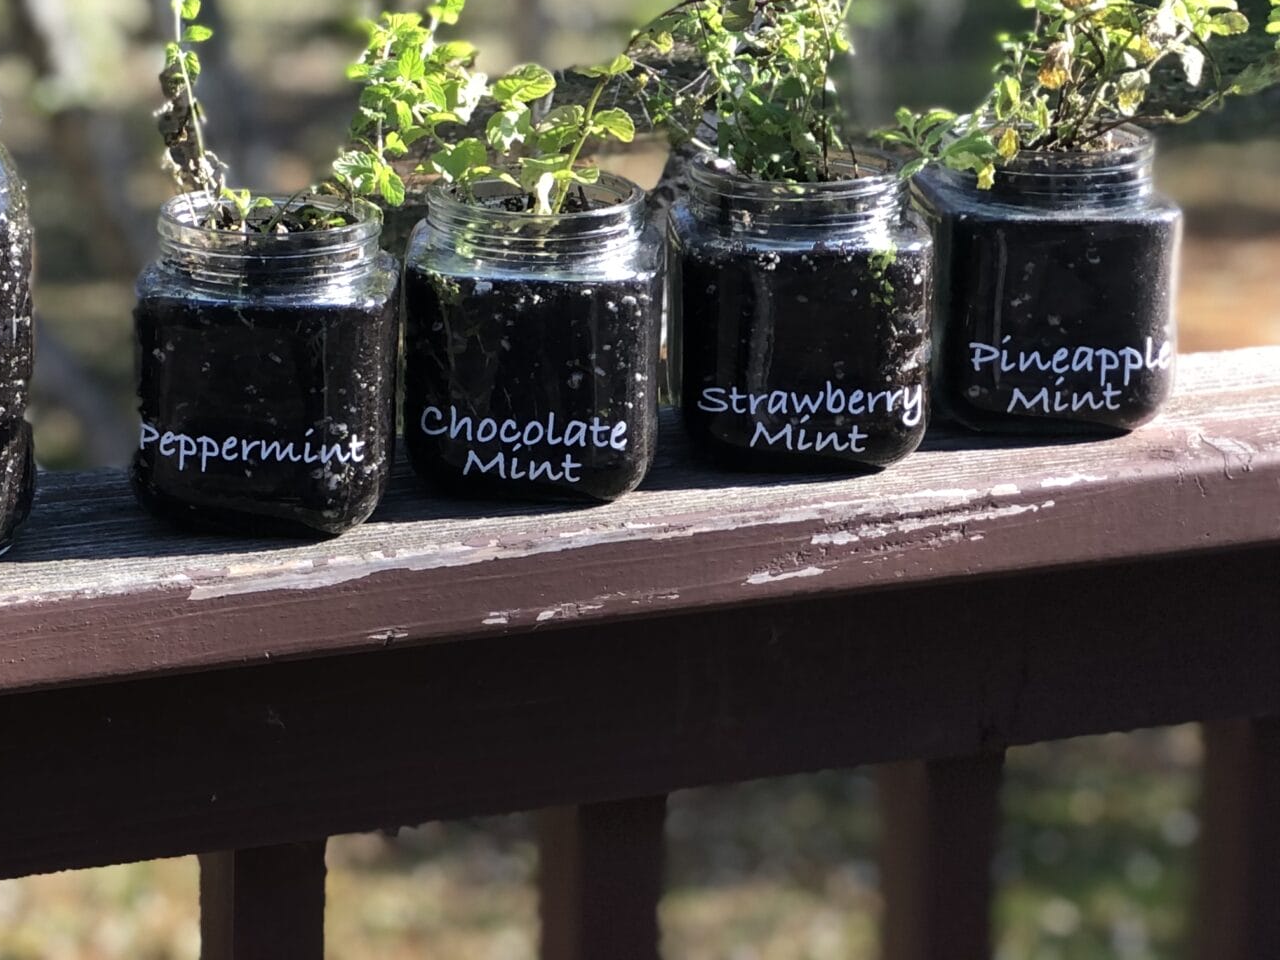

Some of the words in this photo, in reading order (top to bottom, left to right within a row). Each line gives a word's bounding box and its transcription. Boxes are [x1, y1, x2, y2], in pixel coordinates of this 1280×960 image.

[969, 336, 1172, 386] Pineapple
[697, 381, 923, 427] Strawberry
[1007, 378, 1123, 413] Mint
[139, 423, 364, 472] Peppermint
[421, 406, 628, 451] Chocolate
[748, 416, 869, 453] Mint
[463, 443, 582, 483] Mint
